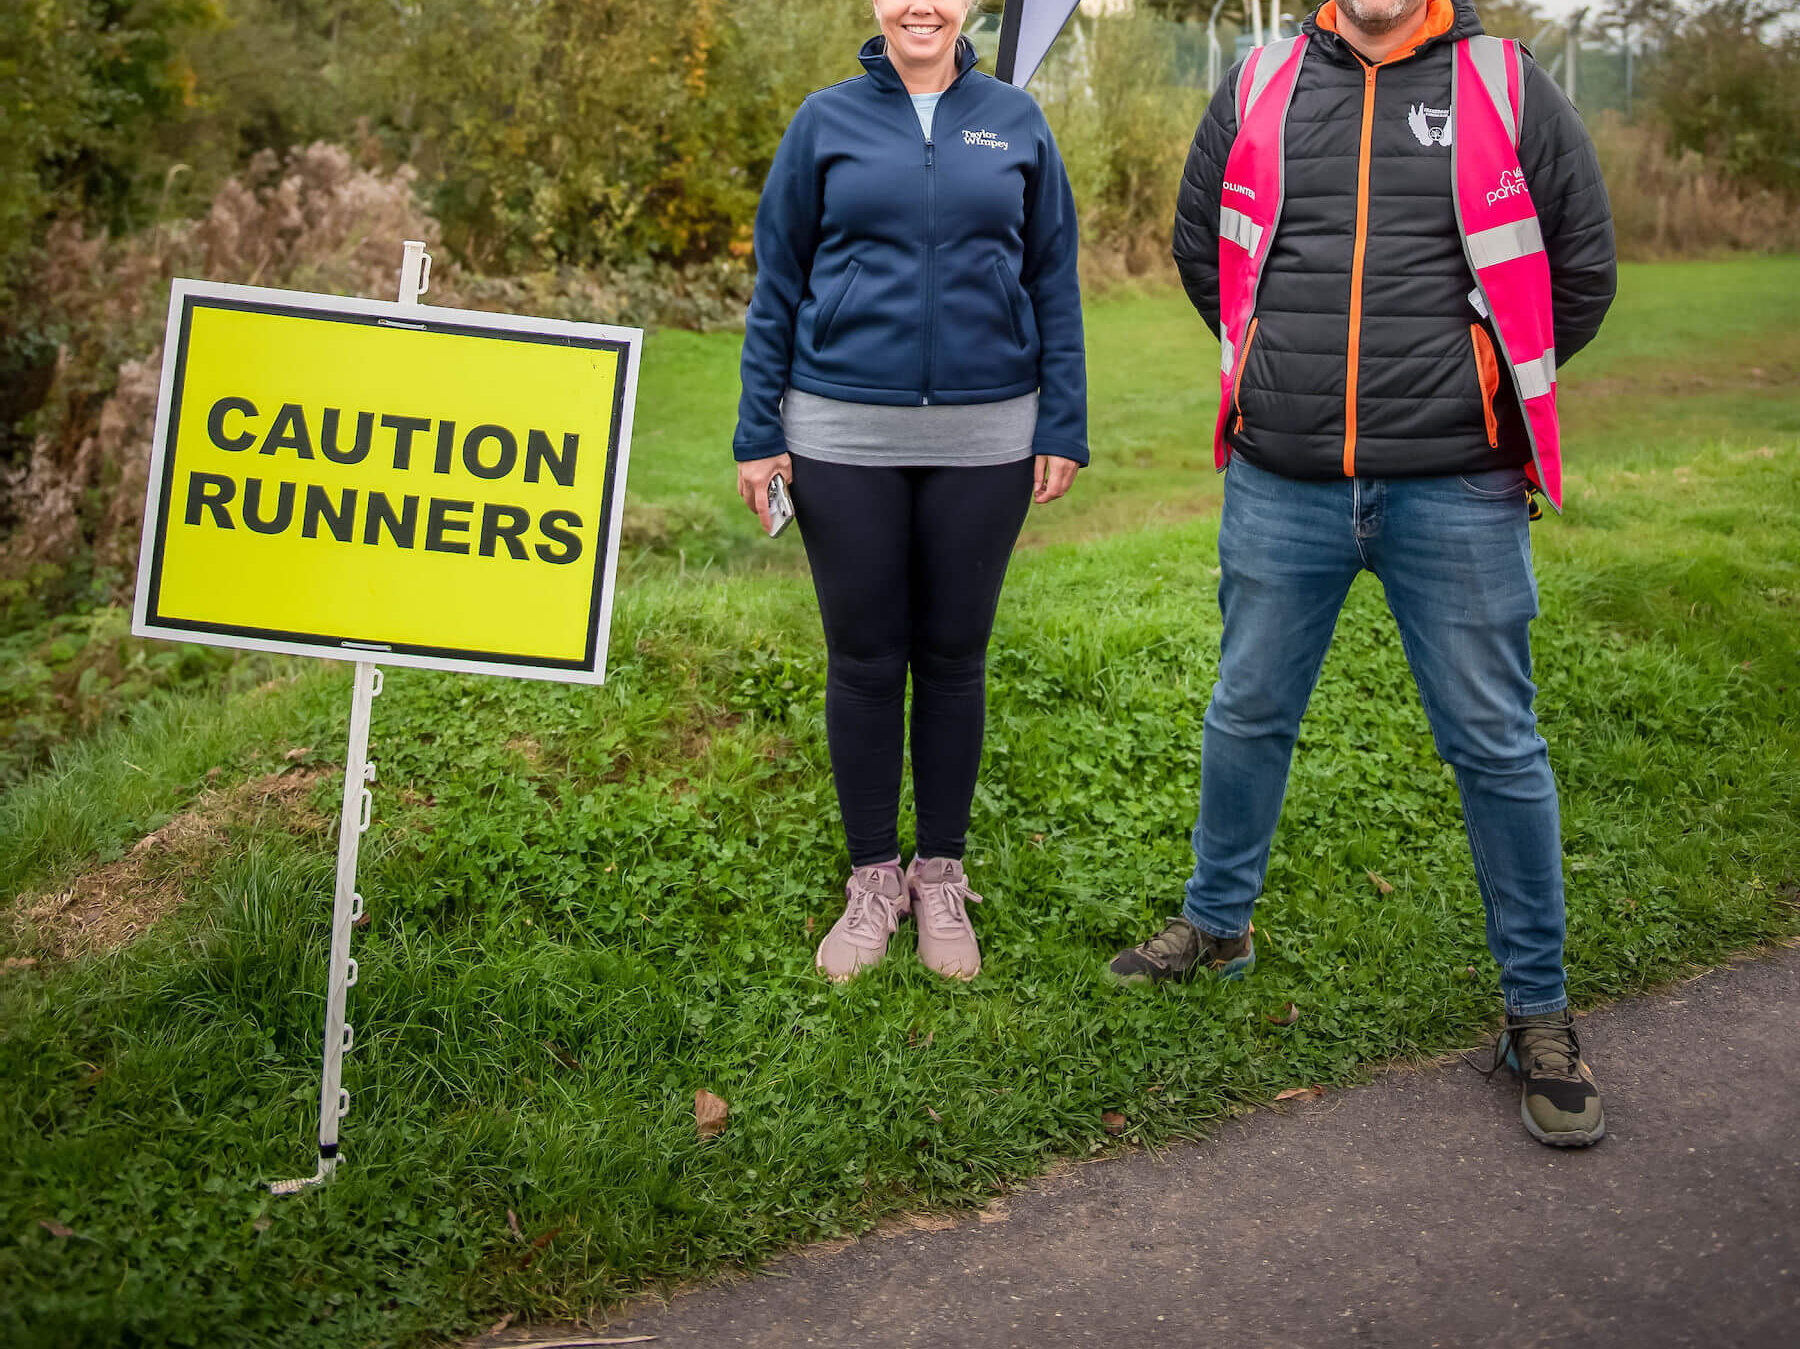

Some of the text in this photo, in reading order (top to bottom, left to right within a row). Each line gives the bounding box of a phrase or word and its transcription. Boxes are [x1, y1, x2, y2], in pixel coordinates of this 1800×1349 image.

[962, 129, 998, 140] Taylor
[963, 137, 1008, 150] Wimpey
[206, 396, 581, 487] CAUTION
[184, 471, 584, 565] RUNNERS
